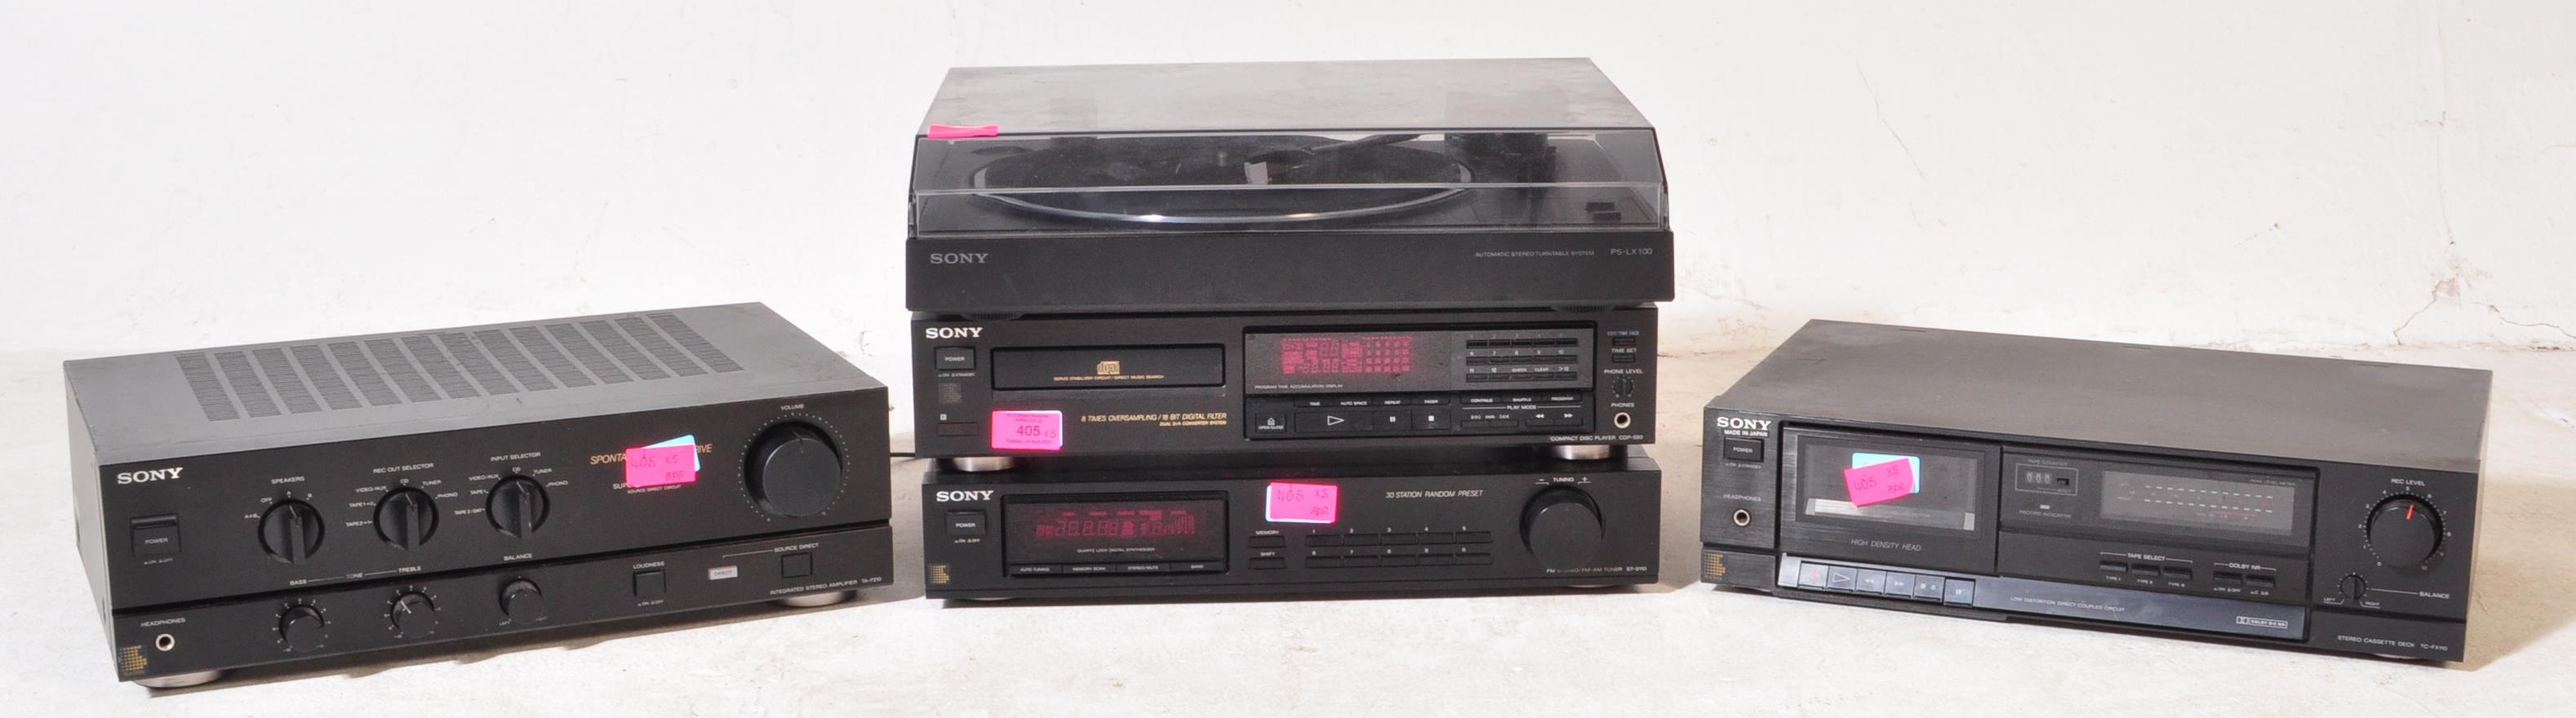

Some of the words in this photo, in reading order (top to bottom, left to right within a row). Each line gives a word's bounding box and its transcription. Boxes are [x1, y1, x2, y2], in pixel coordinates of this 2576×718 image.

[930, 253, 989, 264] SONY
[926, 326, 983, 339] SONY
[1717, 416, 1771, 431] SONY
[1017, 425, 1040, 437] 405
[509, 452, 540, 460] SELECTOR
[402, 463, 434, 472] SELECTOR
[118, 467, 184, 485] SONY
[271, 476, 305, 485] SPEAKERS
[936, 490, 994, 503] SONY
[1724, 494, 1761, 502] HEADPHONES
[144, 537, 168, 545] POWER
[1851, 538, 1868, 547] HIGH
[1871, 540, 1899, 550] DENSITY
[1902, 543, 1922, 552] HEAD
[774, 544, 798, 553] SOURCE
[799, 542, 819, 550] DIRECT
[504, 553, 532, 561] BALANCE
[633, 561, 665, 570] LOUDNESS
[770, 586, 805, 596] INTEGRATED
[828, 579, 858, 589] AMPLIFIER
[2419, 591, 2450, 600] BALANCE
[2023, 597, 2055, 605] DISTORTION
[2077, 602, 2103, 610] COUPLED
[140, 617, 186, 627] HEADPHONES
[2338, 635, 2362, 643] STEREO
[2364, 637, 2396, 647] CASSETTE
